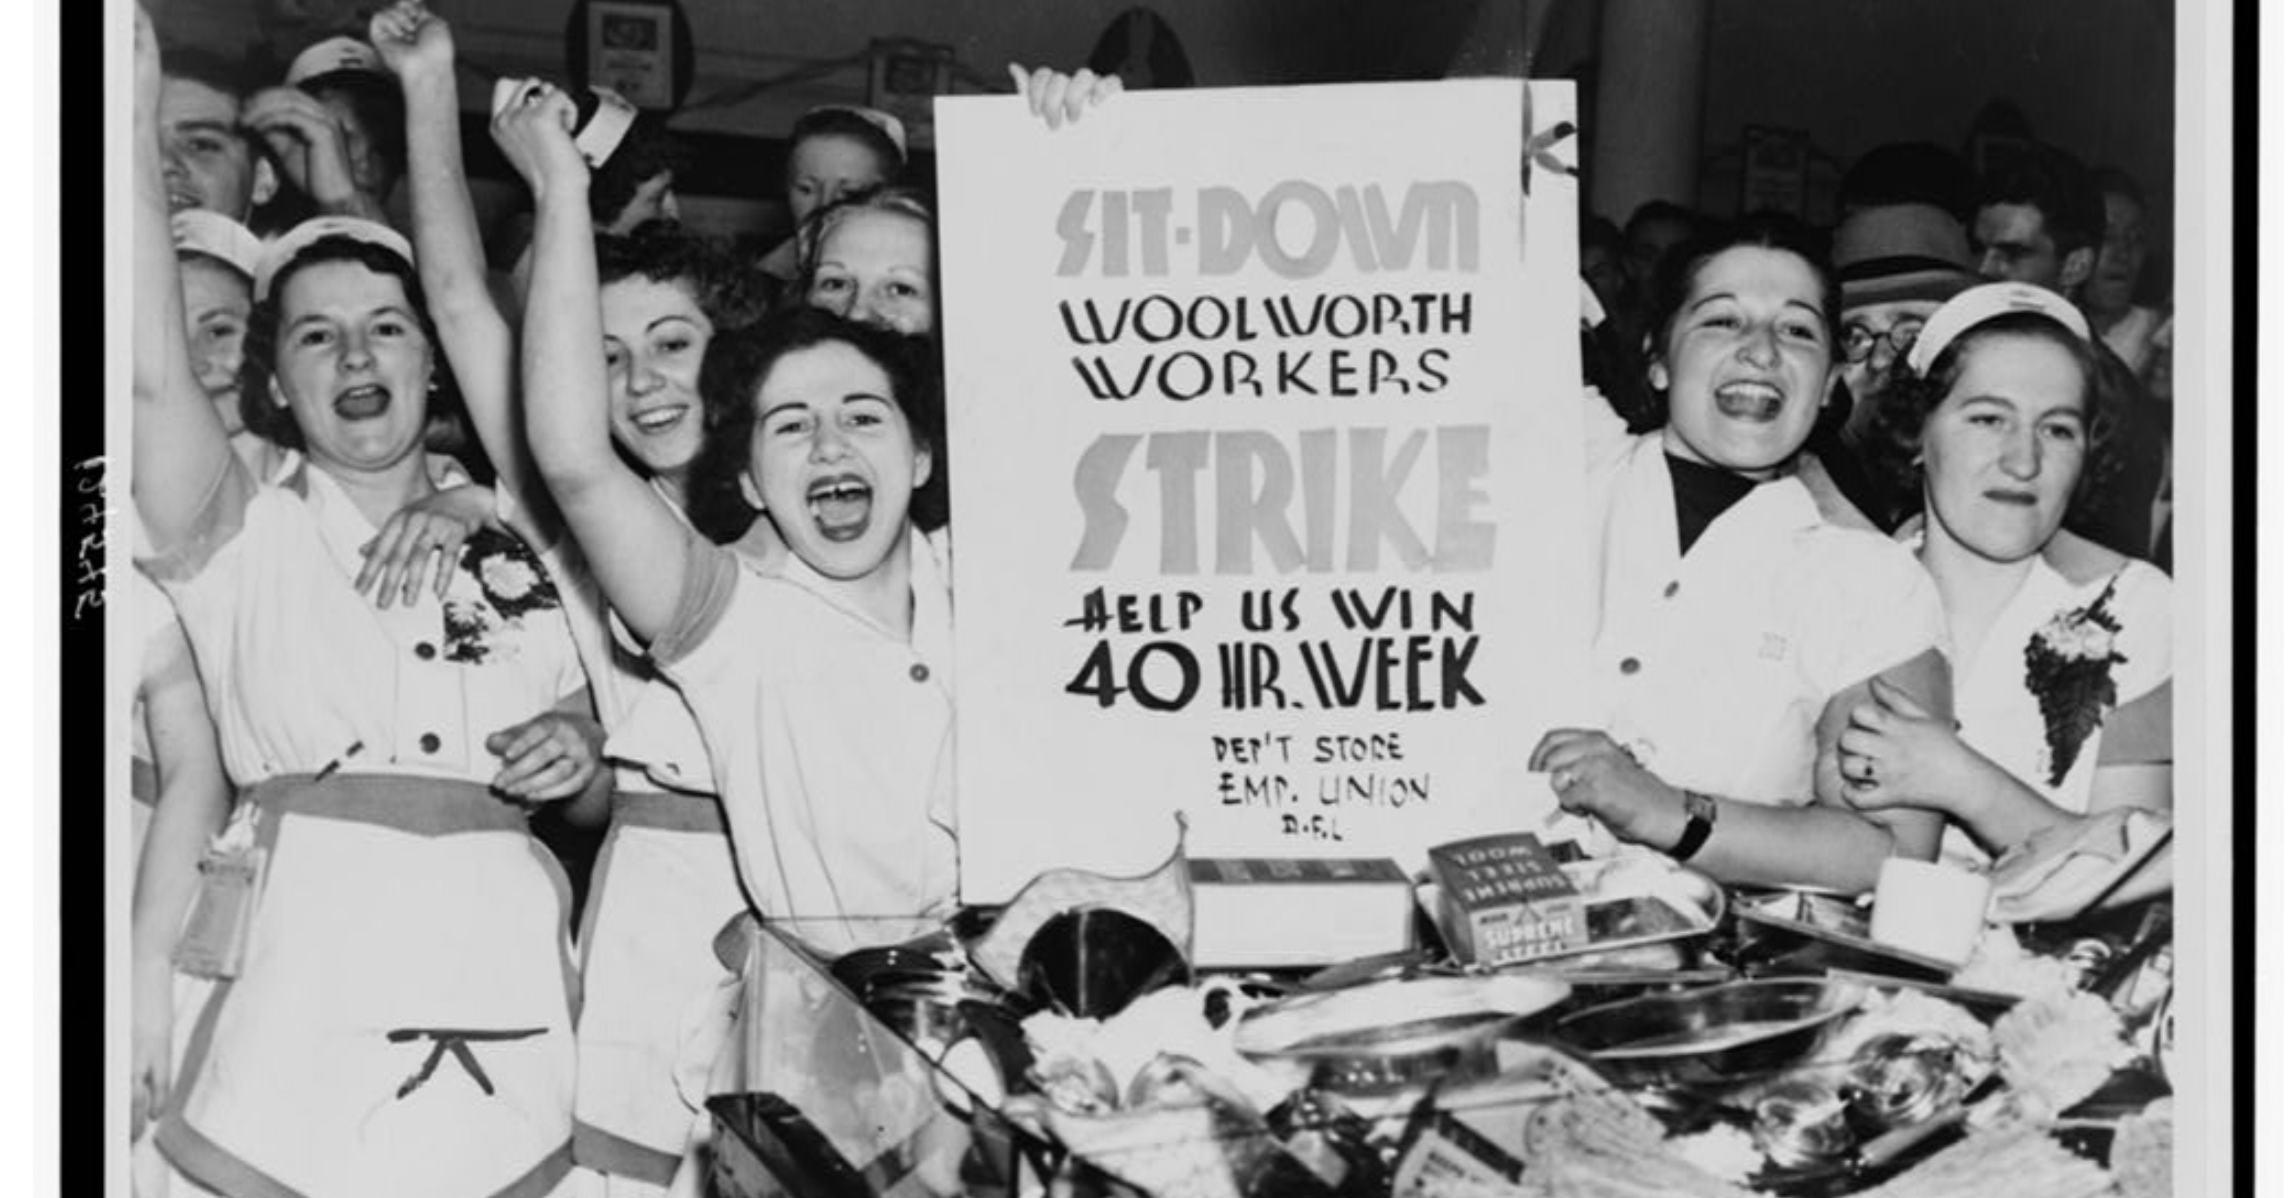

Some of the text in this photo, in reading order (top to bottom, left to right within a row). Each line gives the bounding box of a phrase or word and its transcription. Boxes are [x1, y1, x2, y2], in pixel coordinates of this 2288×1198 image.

[1055, 179, 1480, 280] SIT-DOWN
[1058, 292, 1472, 345] WOOLWORTH
[1071, 348, 1450, 402] WORKERS
[1068, 423, 1498, 577] STRIKE
[1064, 585, 1475, 634] HELP US WIN
[1064, 638, 1202, 713] 40
[1210, 730, 1405, 765] DEP'T STORE
[1217, 770, 1430, 808] EMP. UNION
[1484, 916, 1574, 950] SUPREME
